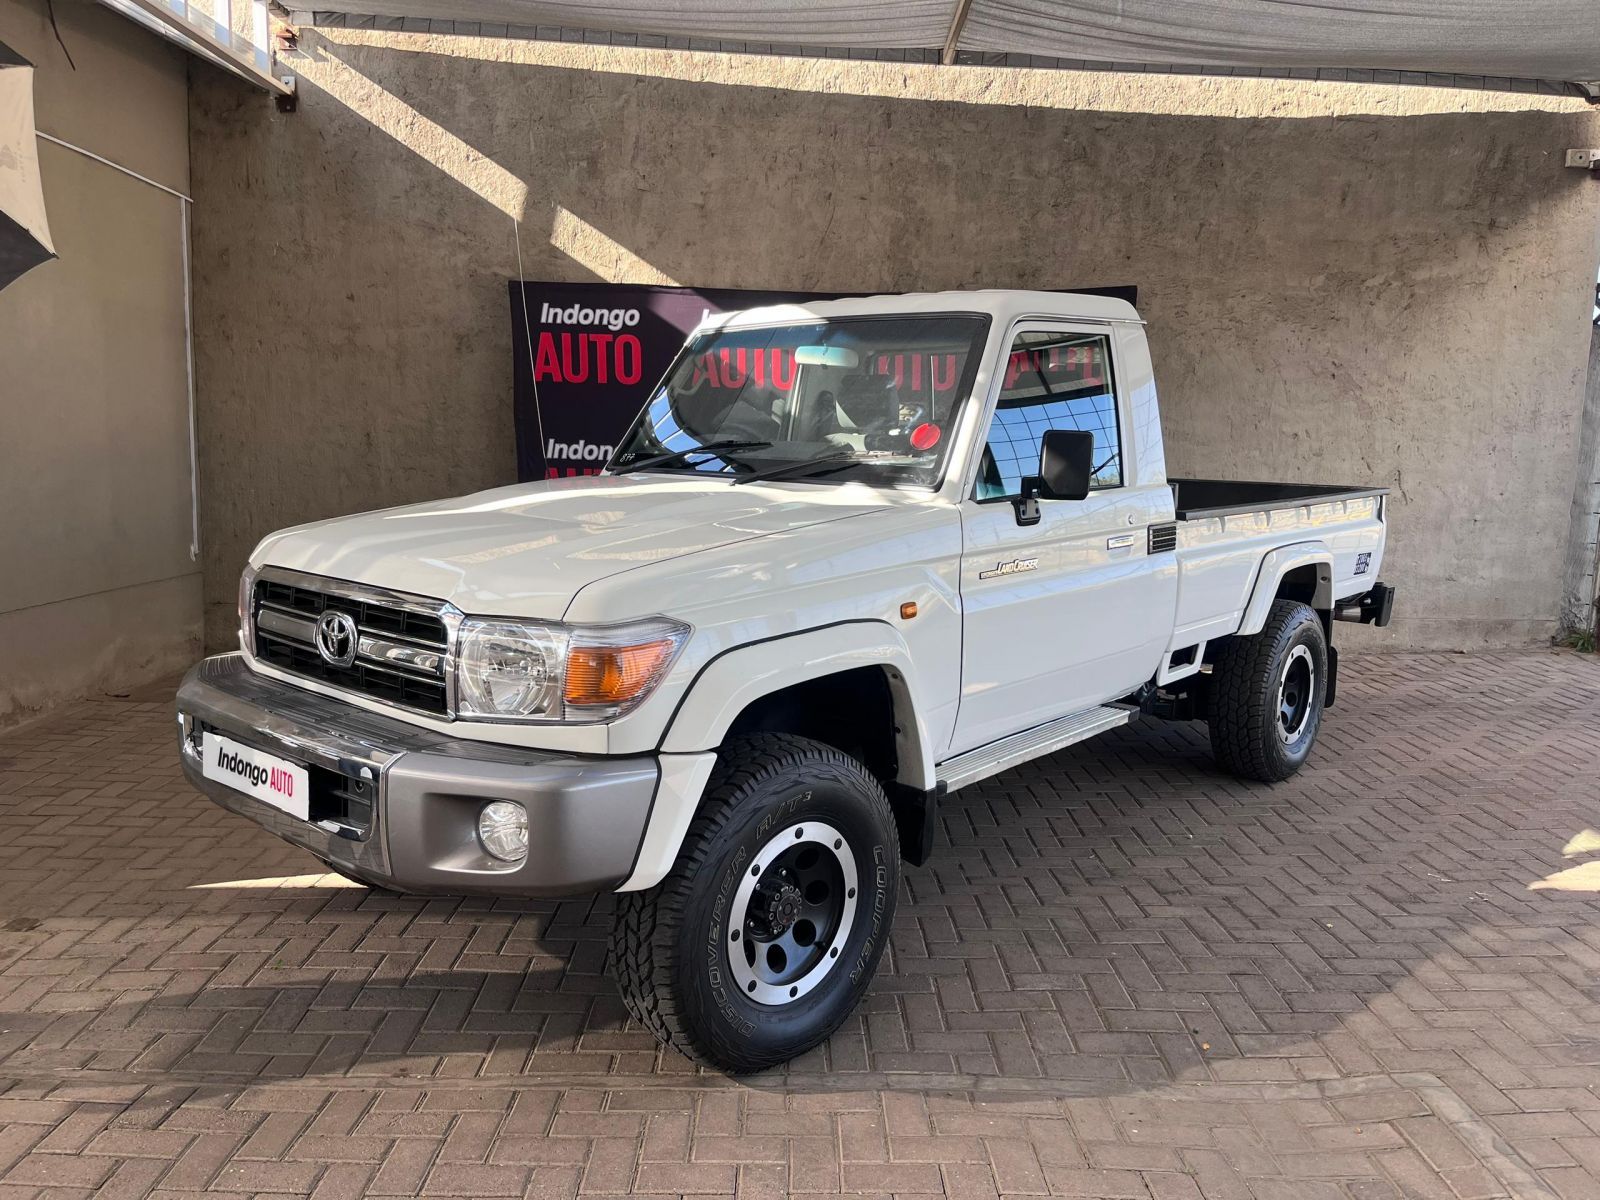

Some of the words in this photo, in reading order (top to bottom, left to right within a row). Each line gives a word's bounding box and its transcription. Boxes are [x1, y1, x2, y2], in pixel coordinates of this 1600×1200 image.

[540, 302, 640, 331] Indongo
[535, 332, 642, 385] AUTO
[547, 438, 617, 461] Indon
[217, 747, 268, 786] Indongo
[269, 767, 294, 798] AUTO
[706, 846, 757, 1038] DISCOVERER
